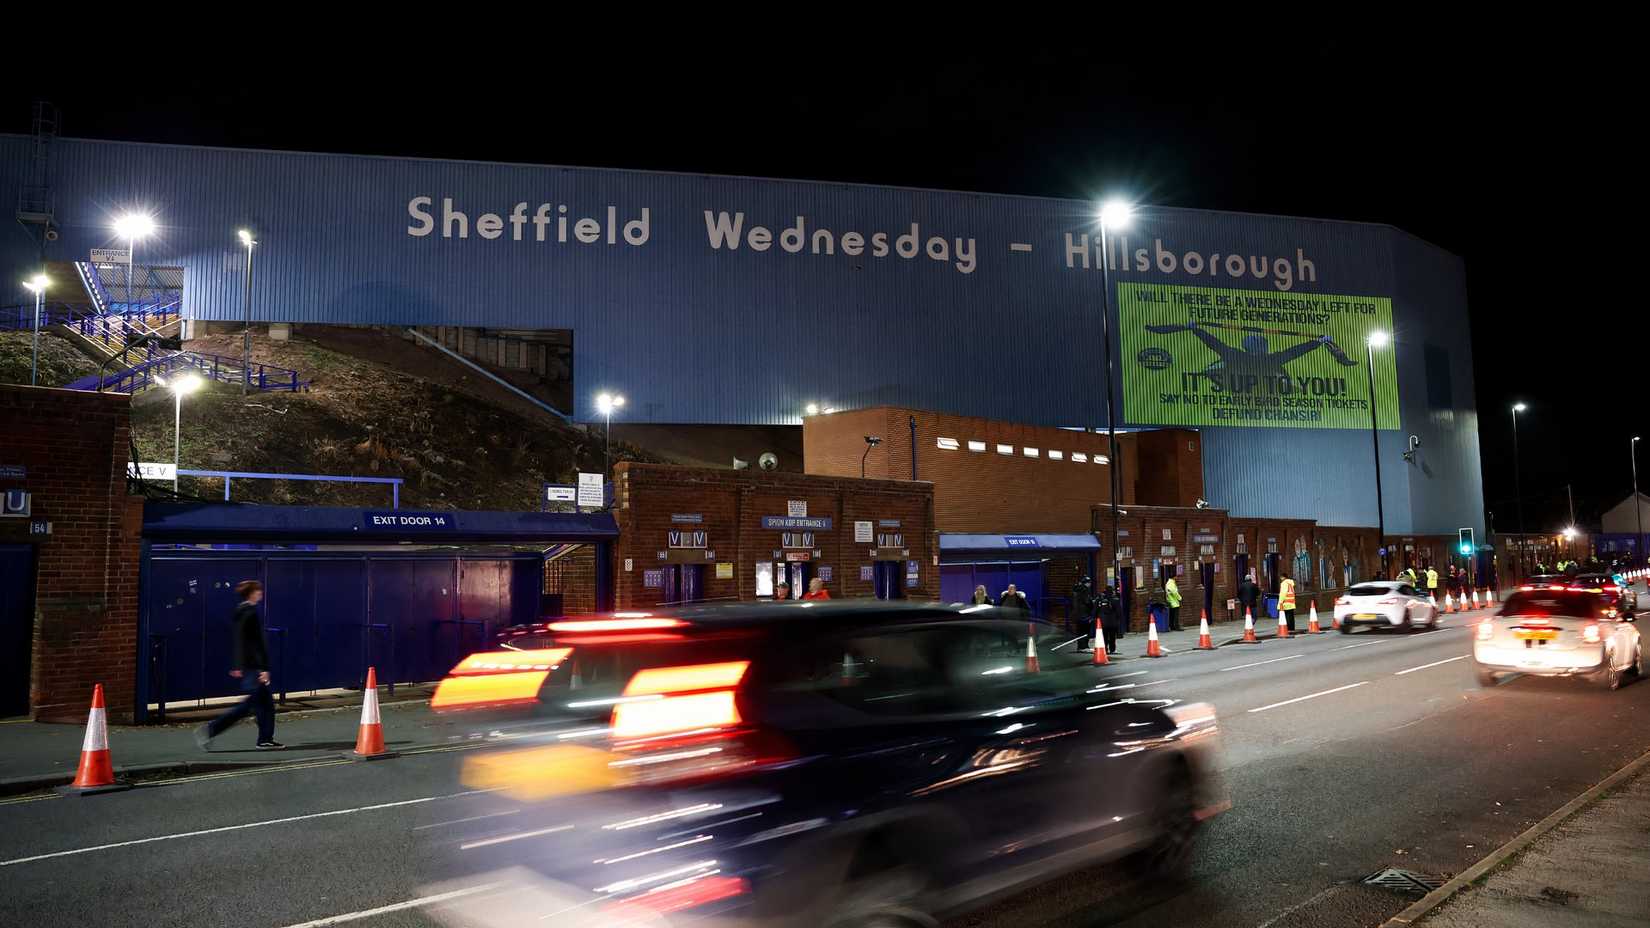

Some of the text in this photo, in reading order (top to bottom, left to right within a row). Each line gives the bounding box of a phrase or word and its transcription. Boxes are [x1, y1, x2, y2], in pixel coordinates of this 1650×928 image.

[407, 196, 650, 246] Sheffield
[704, 210, 977, 274] Wednesday
[1065, 232, 1316, 291] Hillsborough
[1137, 290, 1377, 315] WILL THERE BE A WEDNESDAY LEFT FOR
[1189, 307, 1330, 325] FUTURE GENERATIONS?
[1231, 373, 1259, 394] UP
[1264, 375, 1293, 395] TO
[1297, 375, 1346, 397] YOU!
[1160, 392, 1368, 410] SAY NO TO EARLY BIRD SEASON TICKETS
[1213, 407, 1261, 420] DEFUND
[159, 467, 167, 476] V
[7, 491, 25, 511] U
[34, 523, 45, 533] 54
[373, 516, 445, 526] EXIT DOOR 14
[768, 519, 784, 527] SPION
[785, 519, 795, 527] KOP
[796, 519, 821, 528] ENTRANCE
[671, 531, 704, 545] V V
[784, 533, 812, 545] V V
